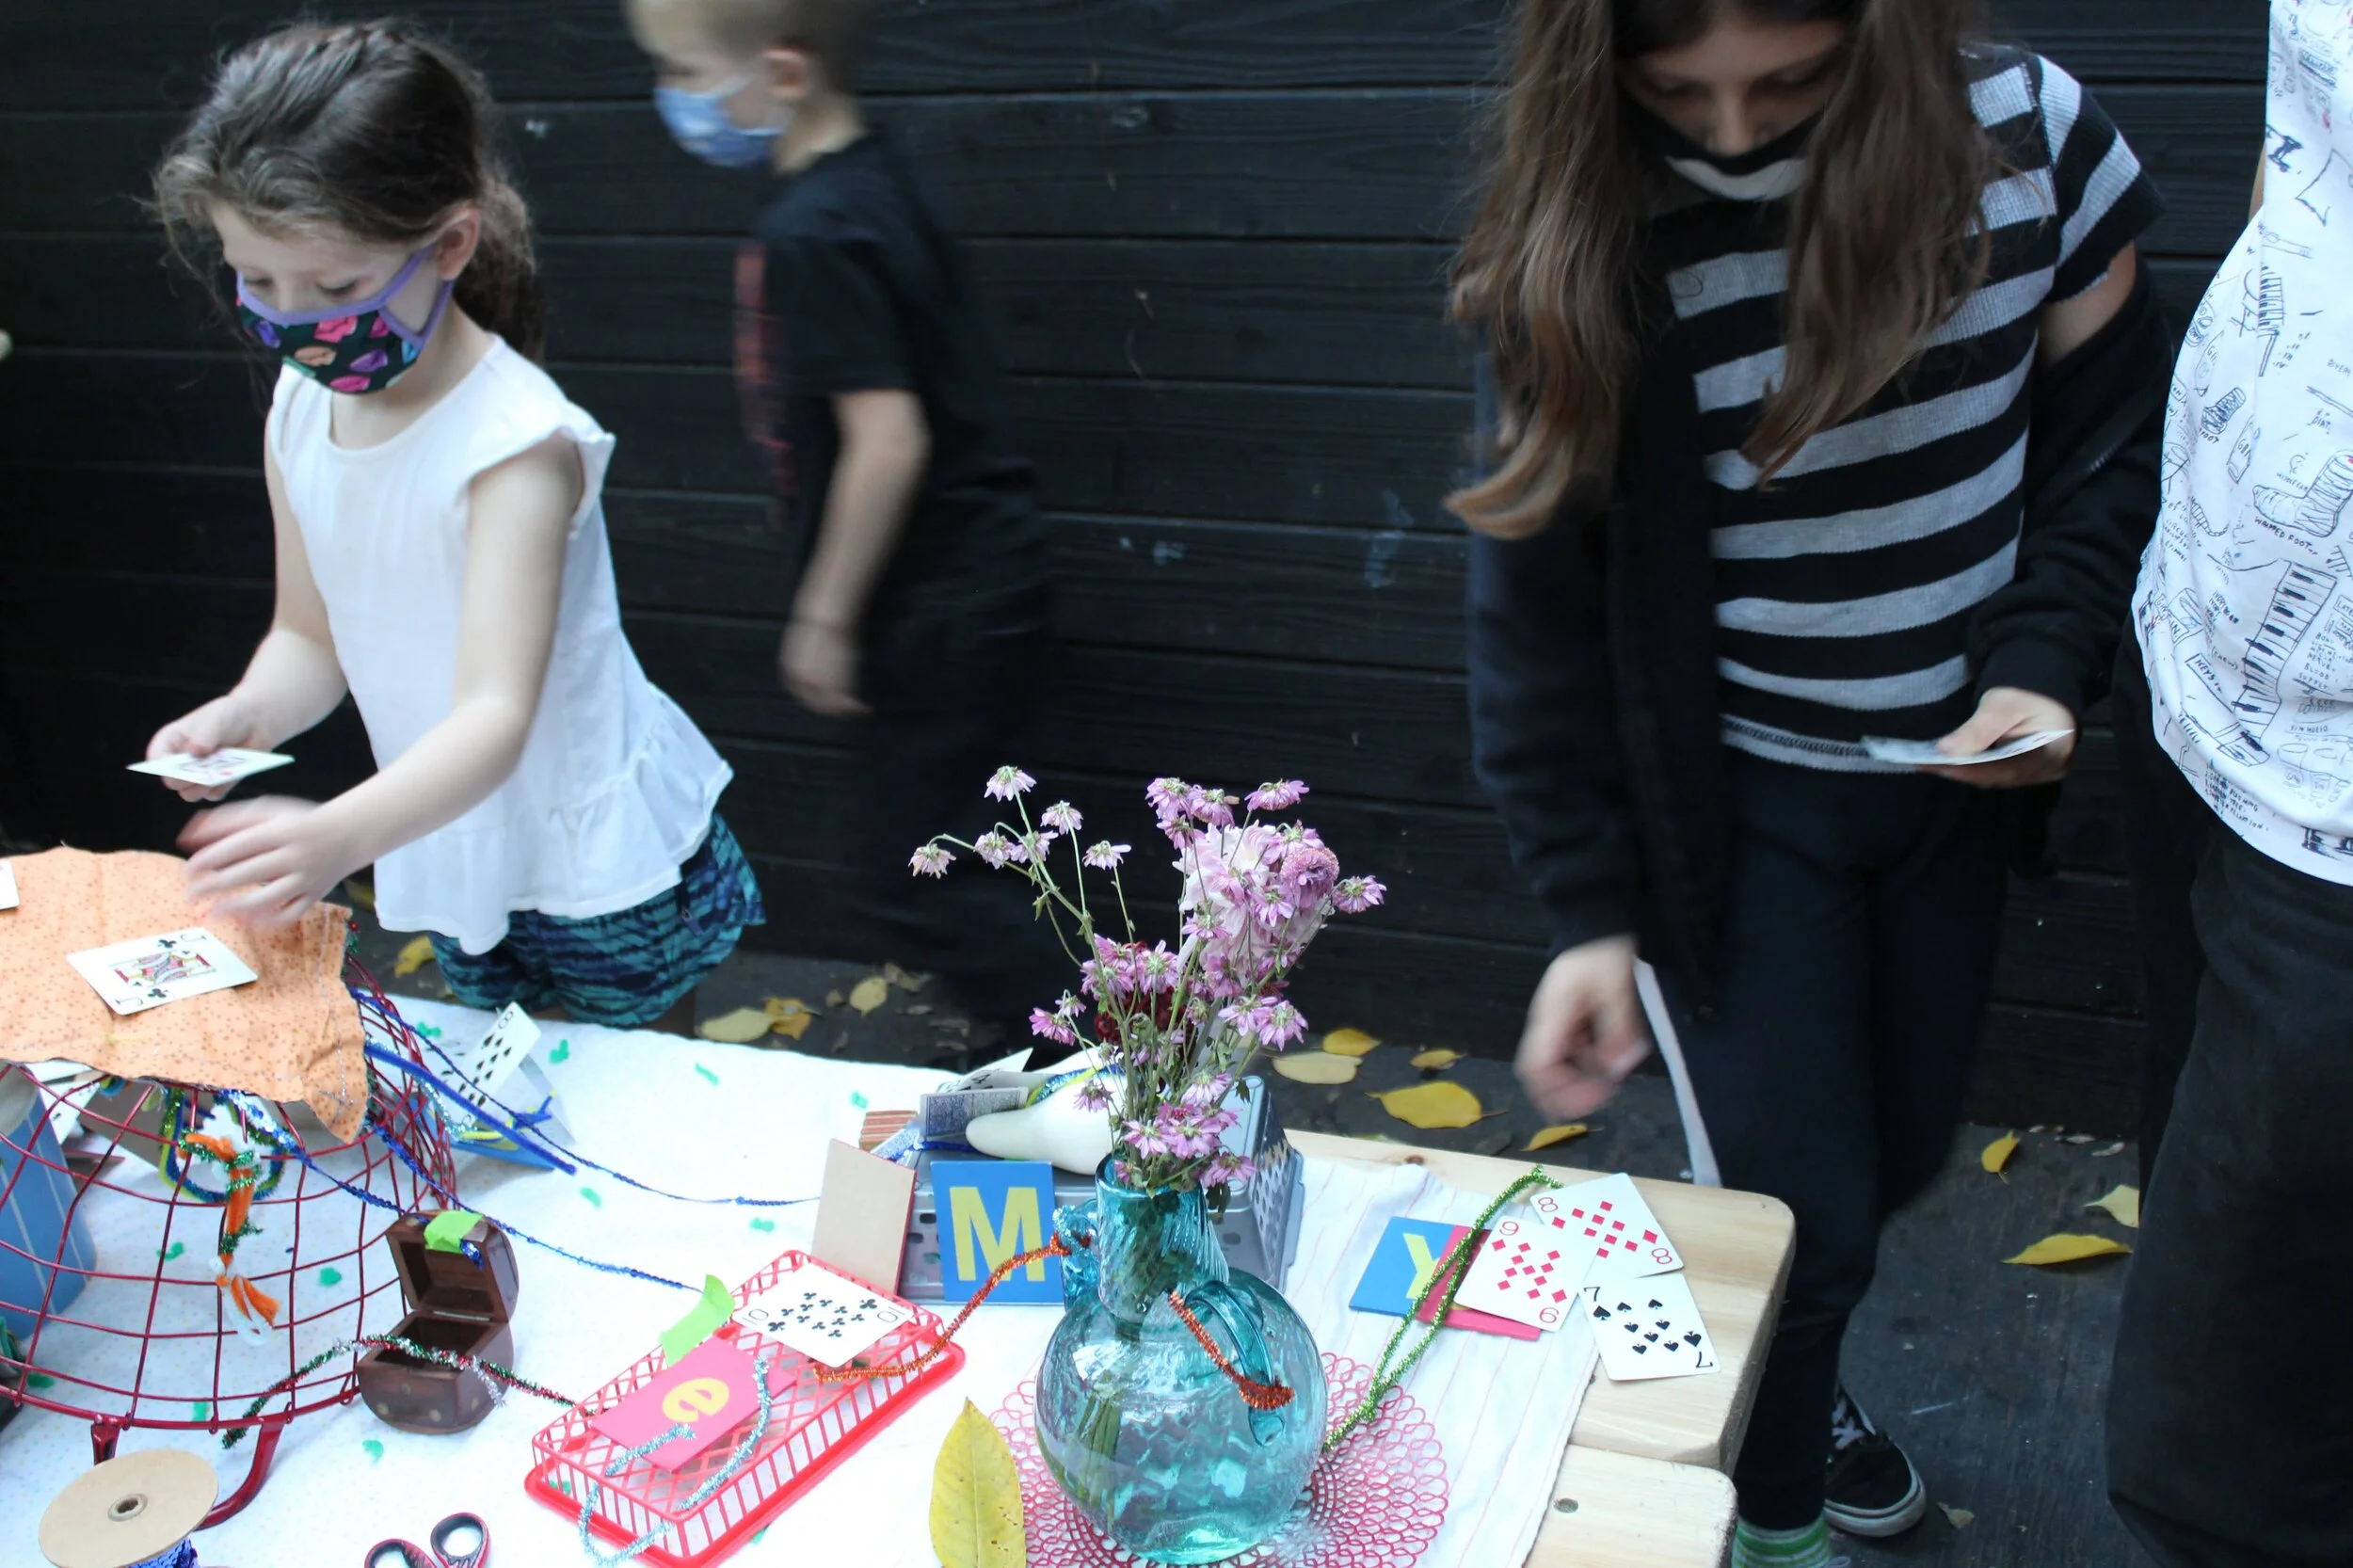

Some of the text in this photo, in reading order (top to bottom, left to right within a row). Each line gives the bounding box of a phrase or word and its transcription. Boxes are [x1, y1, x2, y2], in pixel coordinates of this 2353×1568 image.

[1537, 1196, 1560, 1213] 8
[950, 1186, 1047, 1283] M
[1498, 1220, 1520, 1237] 9
[1651, 1247, 1673, 1265] 8
[1583, 1286, 1601, 1303] 7
[1695, 1351, 1714, 1368] 7
[663, 1377, 730, 1423] e
